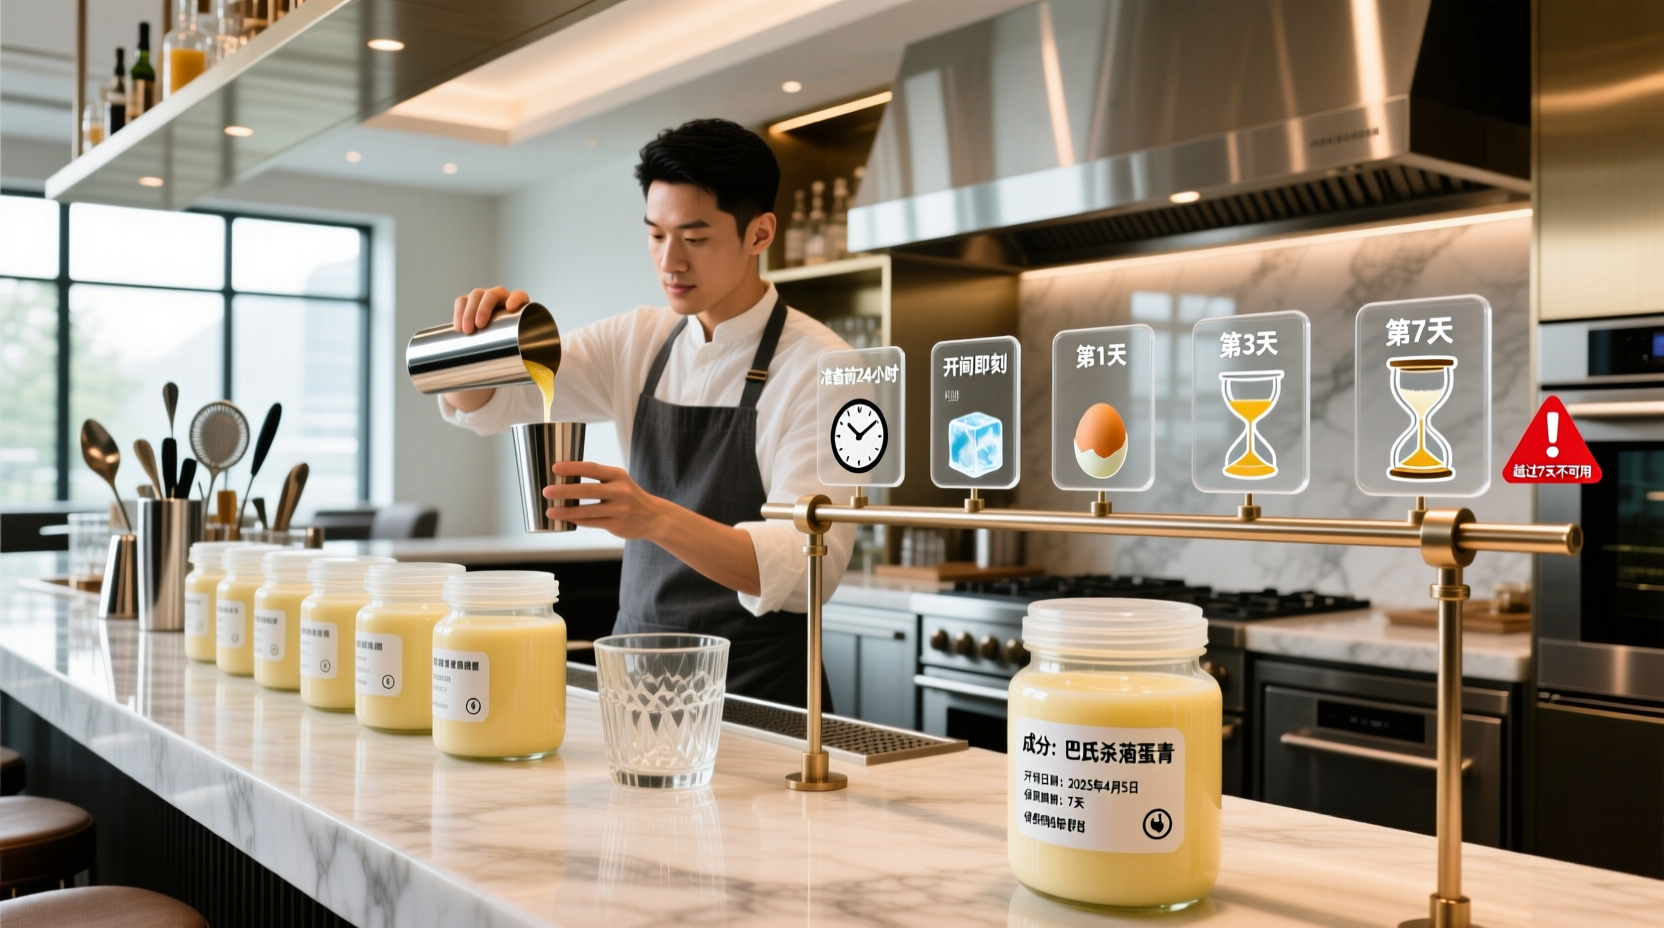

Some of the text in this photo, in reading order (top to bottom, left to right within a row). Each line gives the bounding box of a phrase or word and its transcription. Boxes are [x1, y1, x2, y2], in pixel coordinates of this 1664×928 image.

[1219, 330, 1279, 360] 第3天
[1385, 316, 1454, 347] 第7天
[1075, 343, 1127, 370] 第1天
